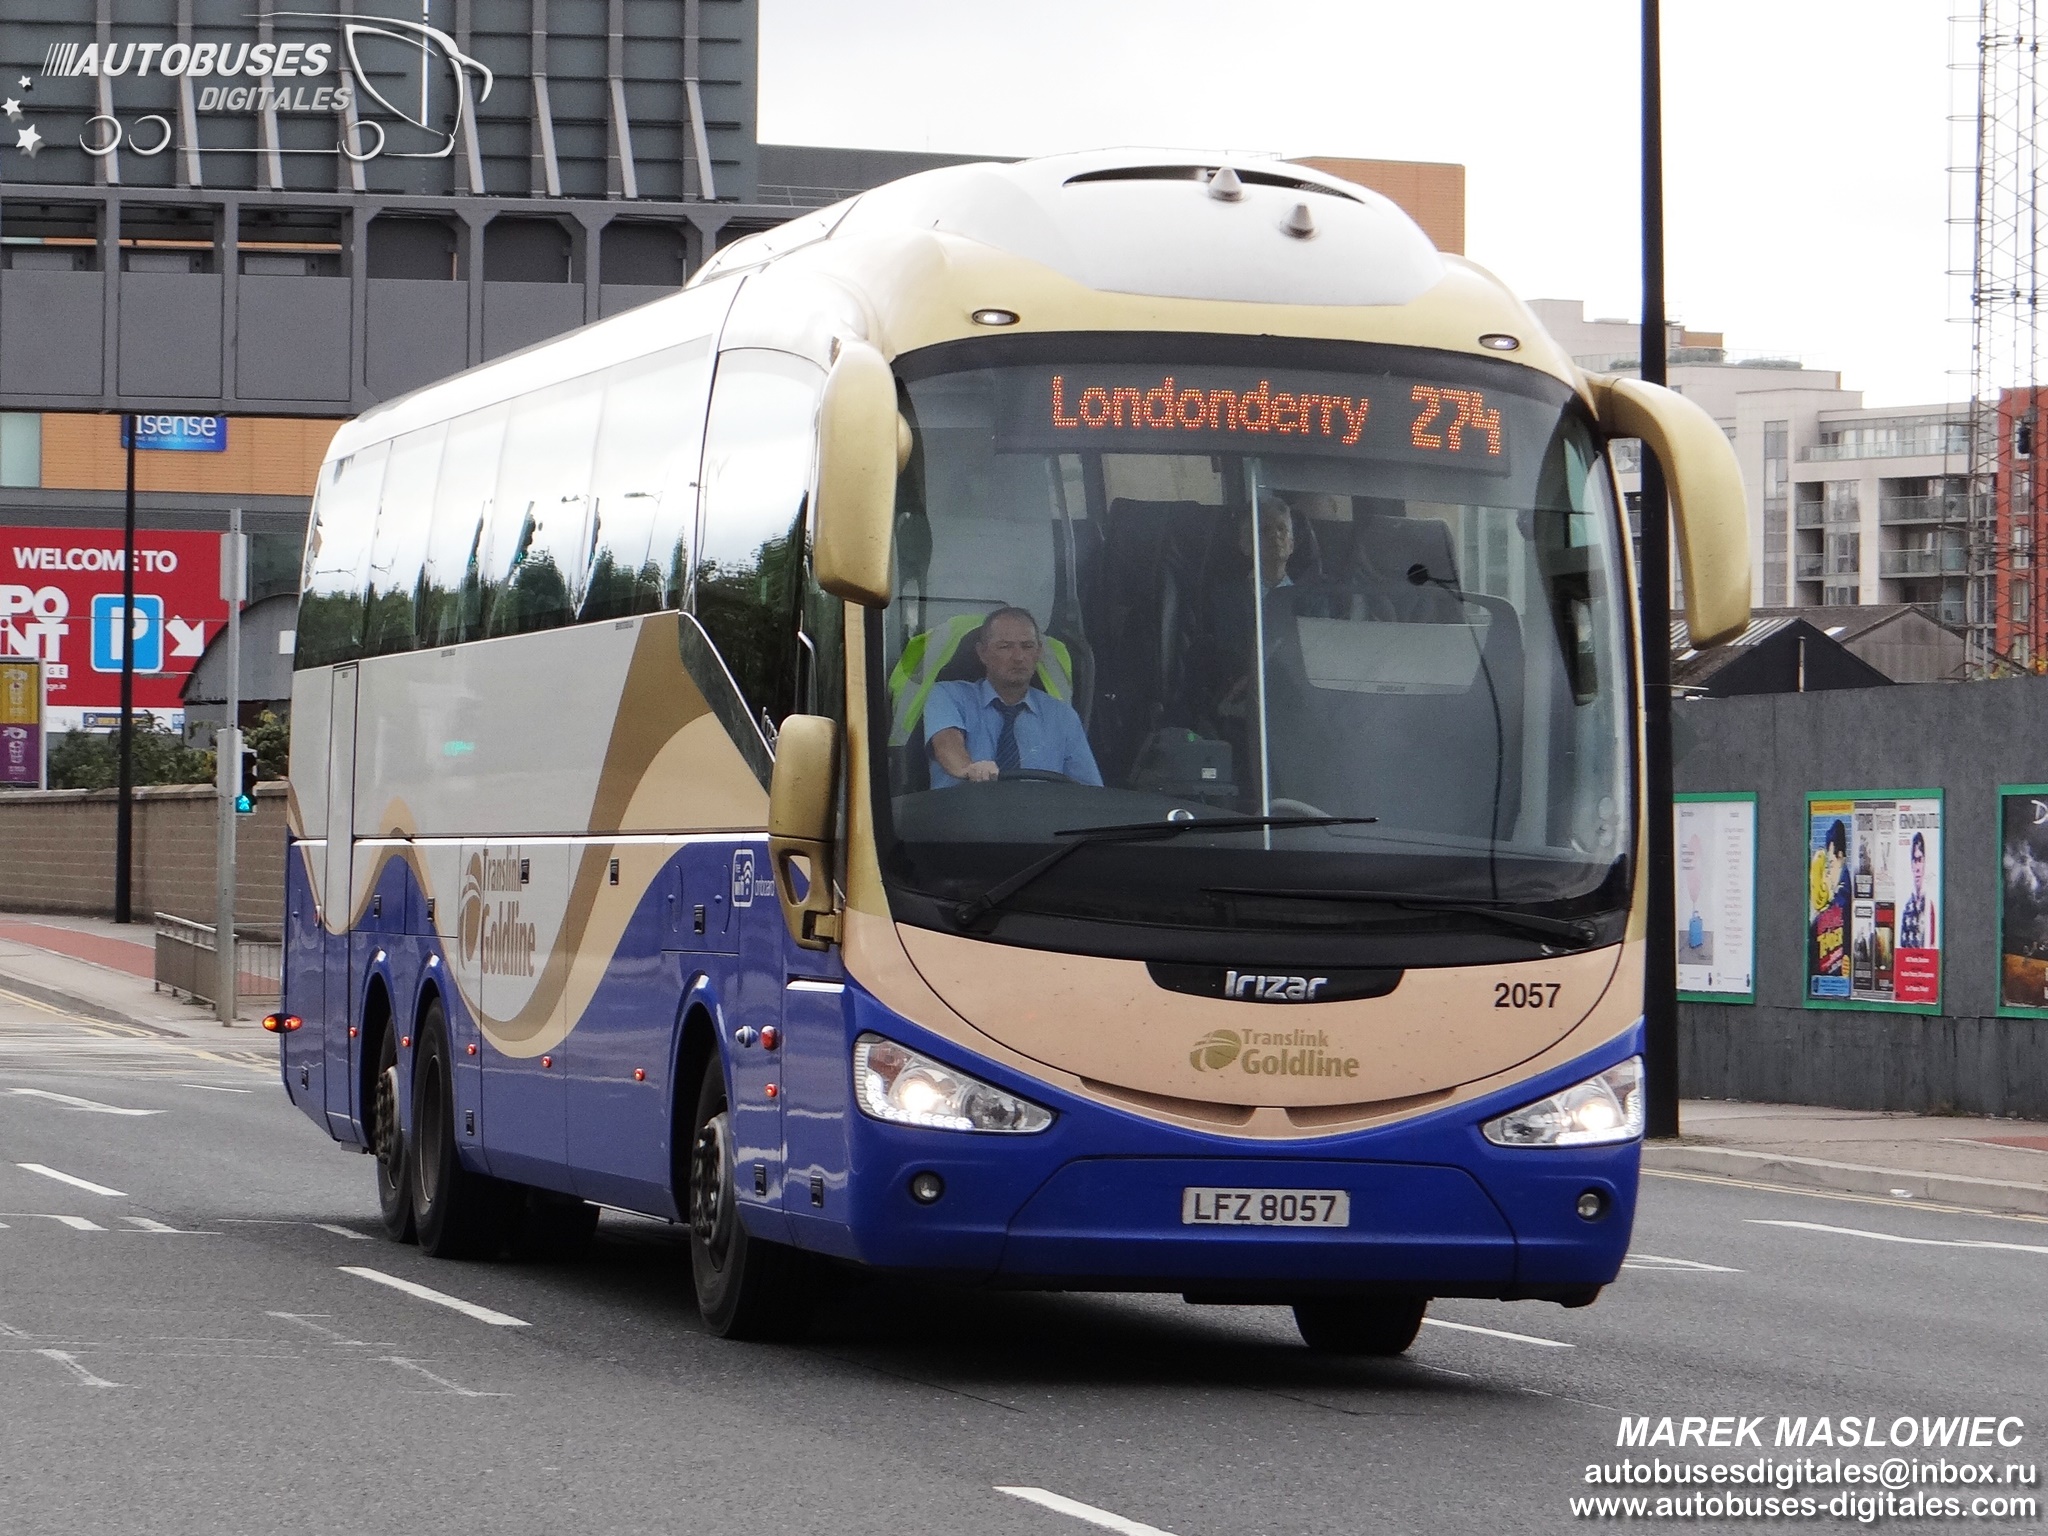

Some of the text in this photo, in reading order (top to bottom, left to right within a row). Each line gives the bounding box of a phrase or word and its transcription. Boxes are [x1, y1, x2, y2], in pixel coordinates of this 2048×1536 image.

[1052, 375, 1501, 454] Londonderry 274
[13, 546, 178, 573] WELCOME TO
[482, 900, 536, 978] Goldline
[1224, 970, 1328, 1000] Irizar
[1494, 983, 1561, 1009] 2057
[1241, 1028, 1330, 1049] Translink
[1241, 1048, 1360, 1079] Goldline
[1193, 1193, 1338, 1223] LFZ 8057
